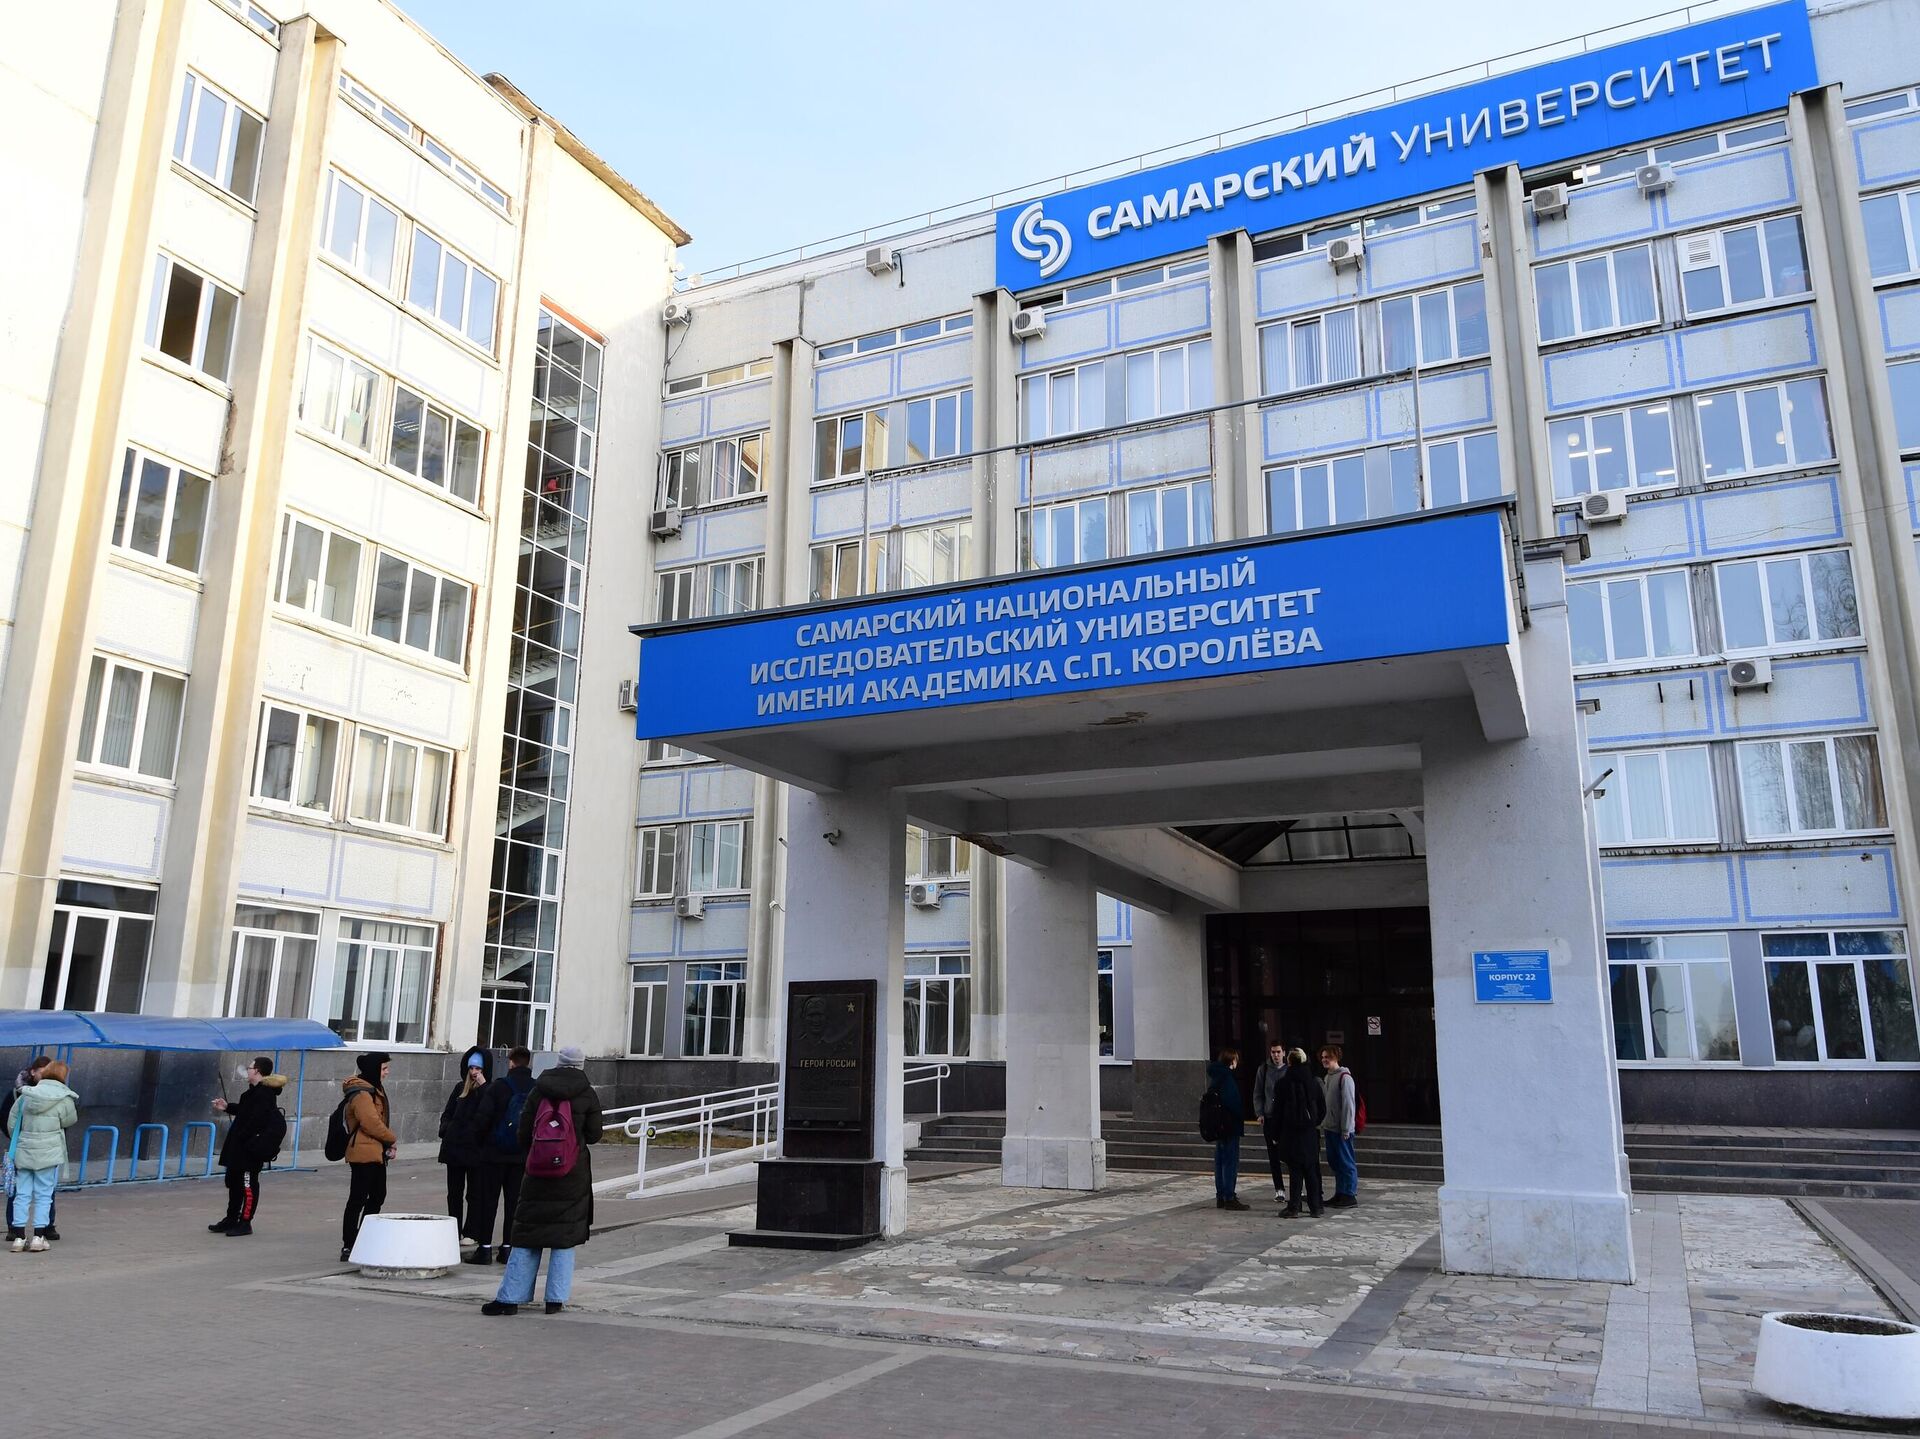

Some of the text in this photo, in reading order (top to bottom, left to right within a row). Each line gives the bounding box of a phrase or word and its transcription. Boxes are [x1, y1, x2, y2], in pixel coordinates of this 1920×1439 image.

[1087, 32, 1782, 240] САМАРСКИЙ УНИВЕРСИТЕТ
[750, 587, 1321, 685] ИССЛЕДОВАТЕЛЬСКИЙ УНИВЕРСИТЕТ
[796, 555, 1256, 647] САМАРСКИЙ НАЦИОНАЛЬНЫЙ
[757, 626, 1324, 716] ИМЕНИ АКАДЕМИКА С.П. КОРОЛЁВА
[1488, 973, 1537, 982] КОРПУС 22
[825, 1059, 856, 1068] РОССИИ
